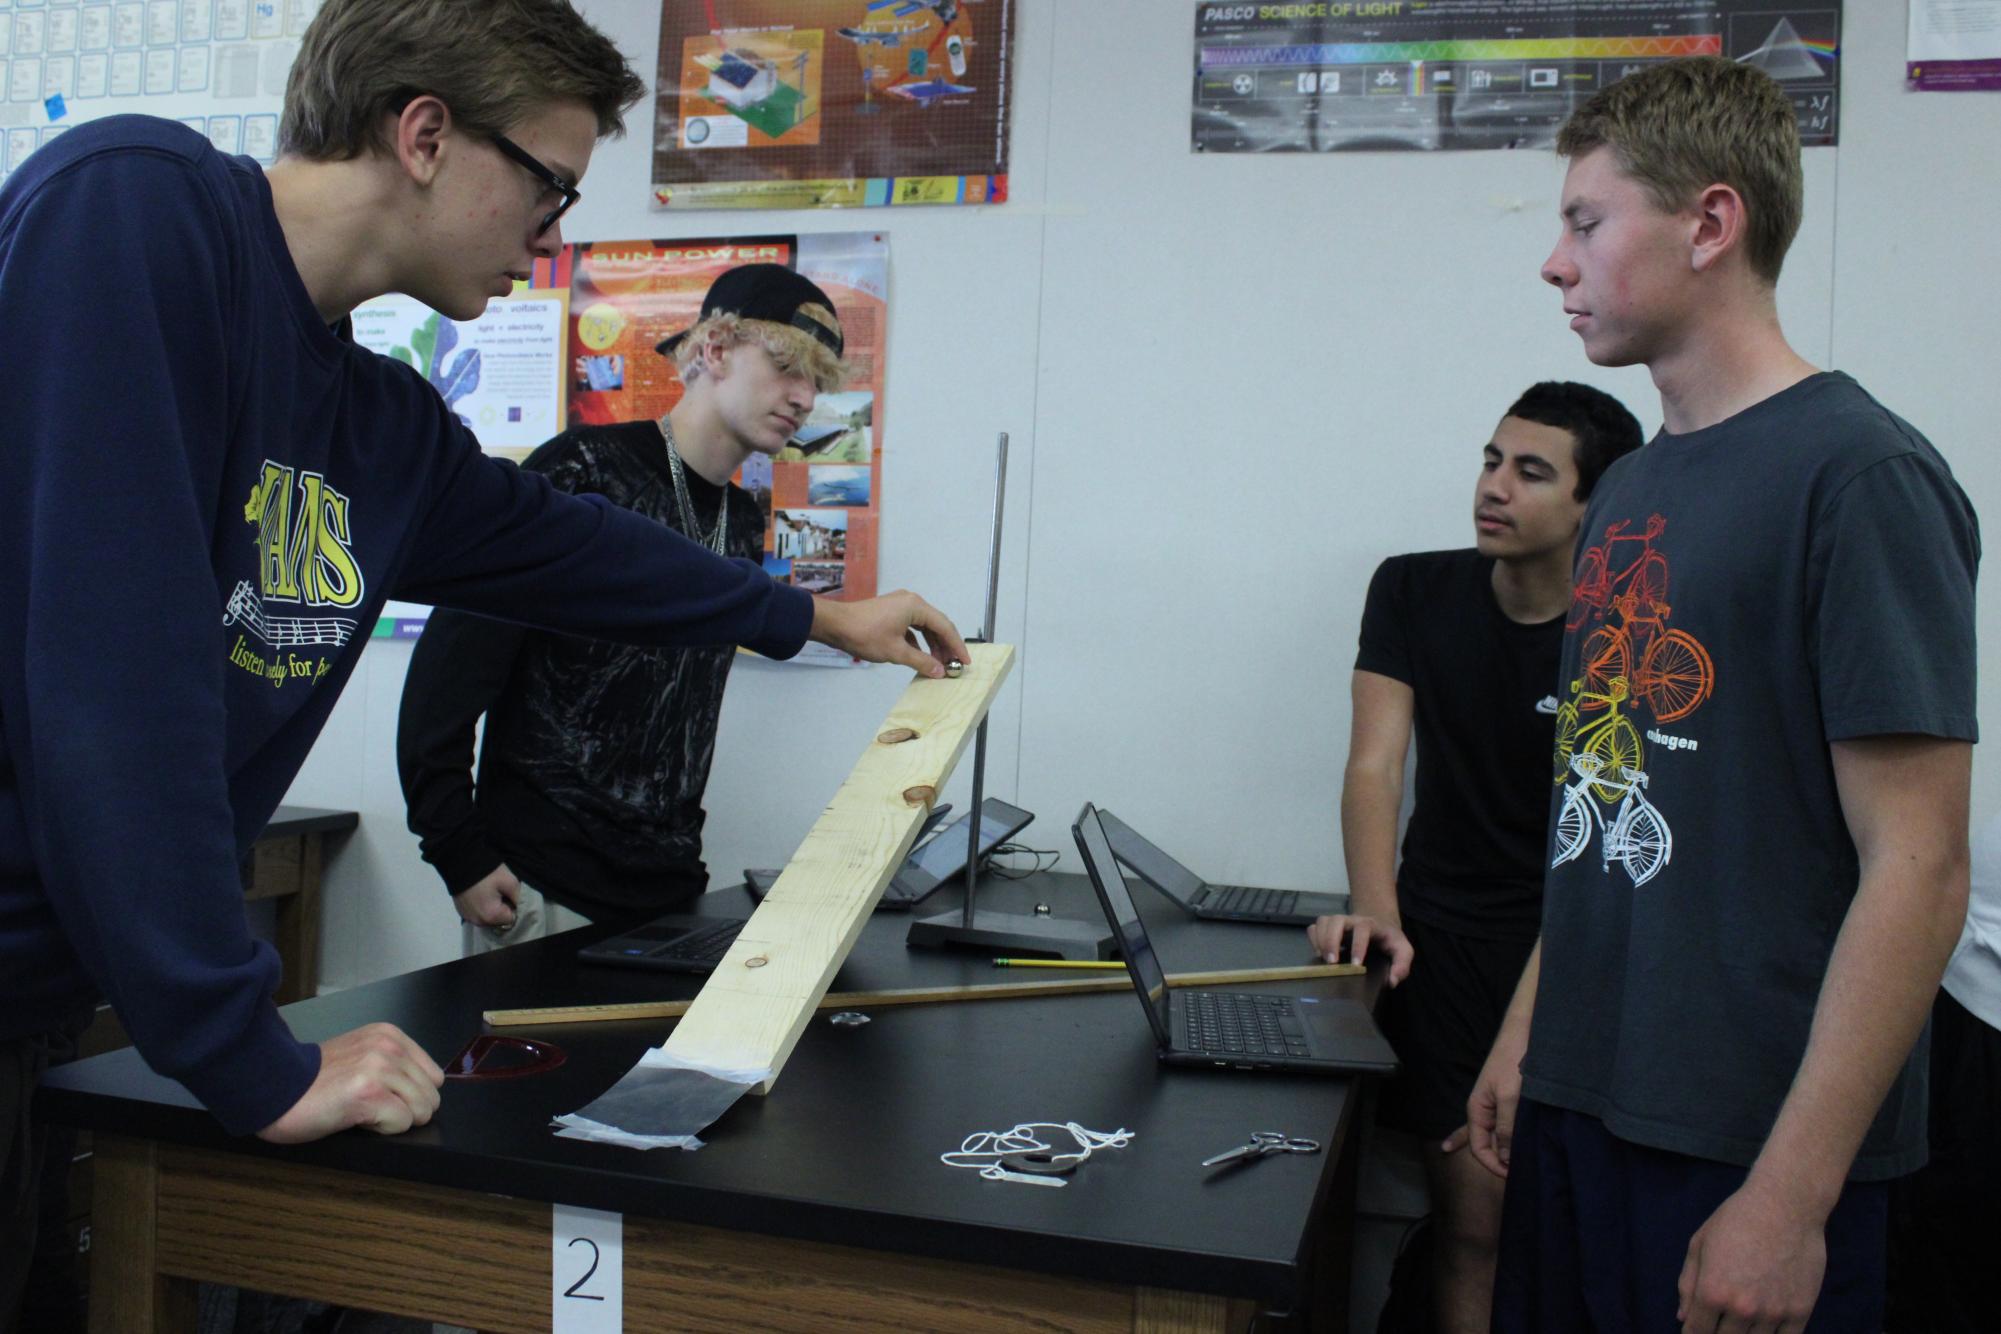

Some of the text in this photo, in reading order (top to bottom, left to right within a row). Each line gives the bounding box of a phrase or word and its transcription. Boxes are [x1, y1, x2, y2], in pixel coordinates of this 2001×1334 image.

[256, 3, 274, 17] Hg
[1204, 6, 1255, 21] PASCO
[1259, 3, 1327, 19] SCIENCE
[1330, 3, 1353, 16] OF
[1356, 2, 1403, 16] LIGHT
[591, 247, 778, 262] SUN POWER
[485, 303, 548, 313] oto voltaics
[507, 323, 545, 333] electricity
[229, 634, 265, 676] listen
[289, 653, 312, 677] for
[563, 1236, 605, 1301] 2
